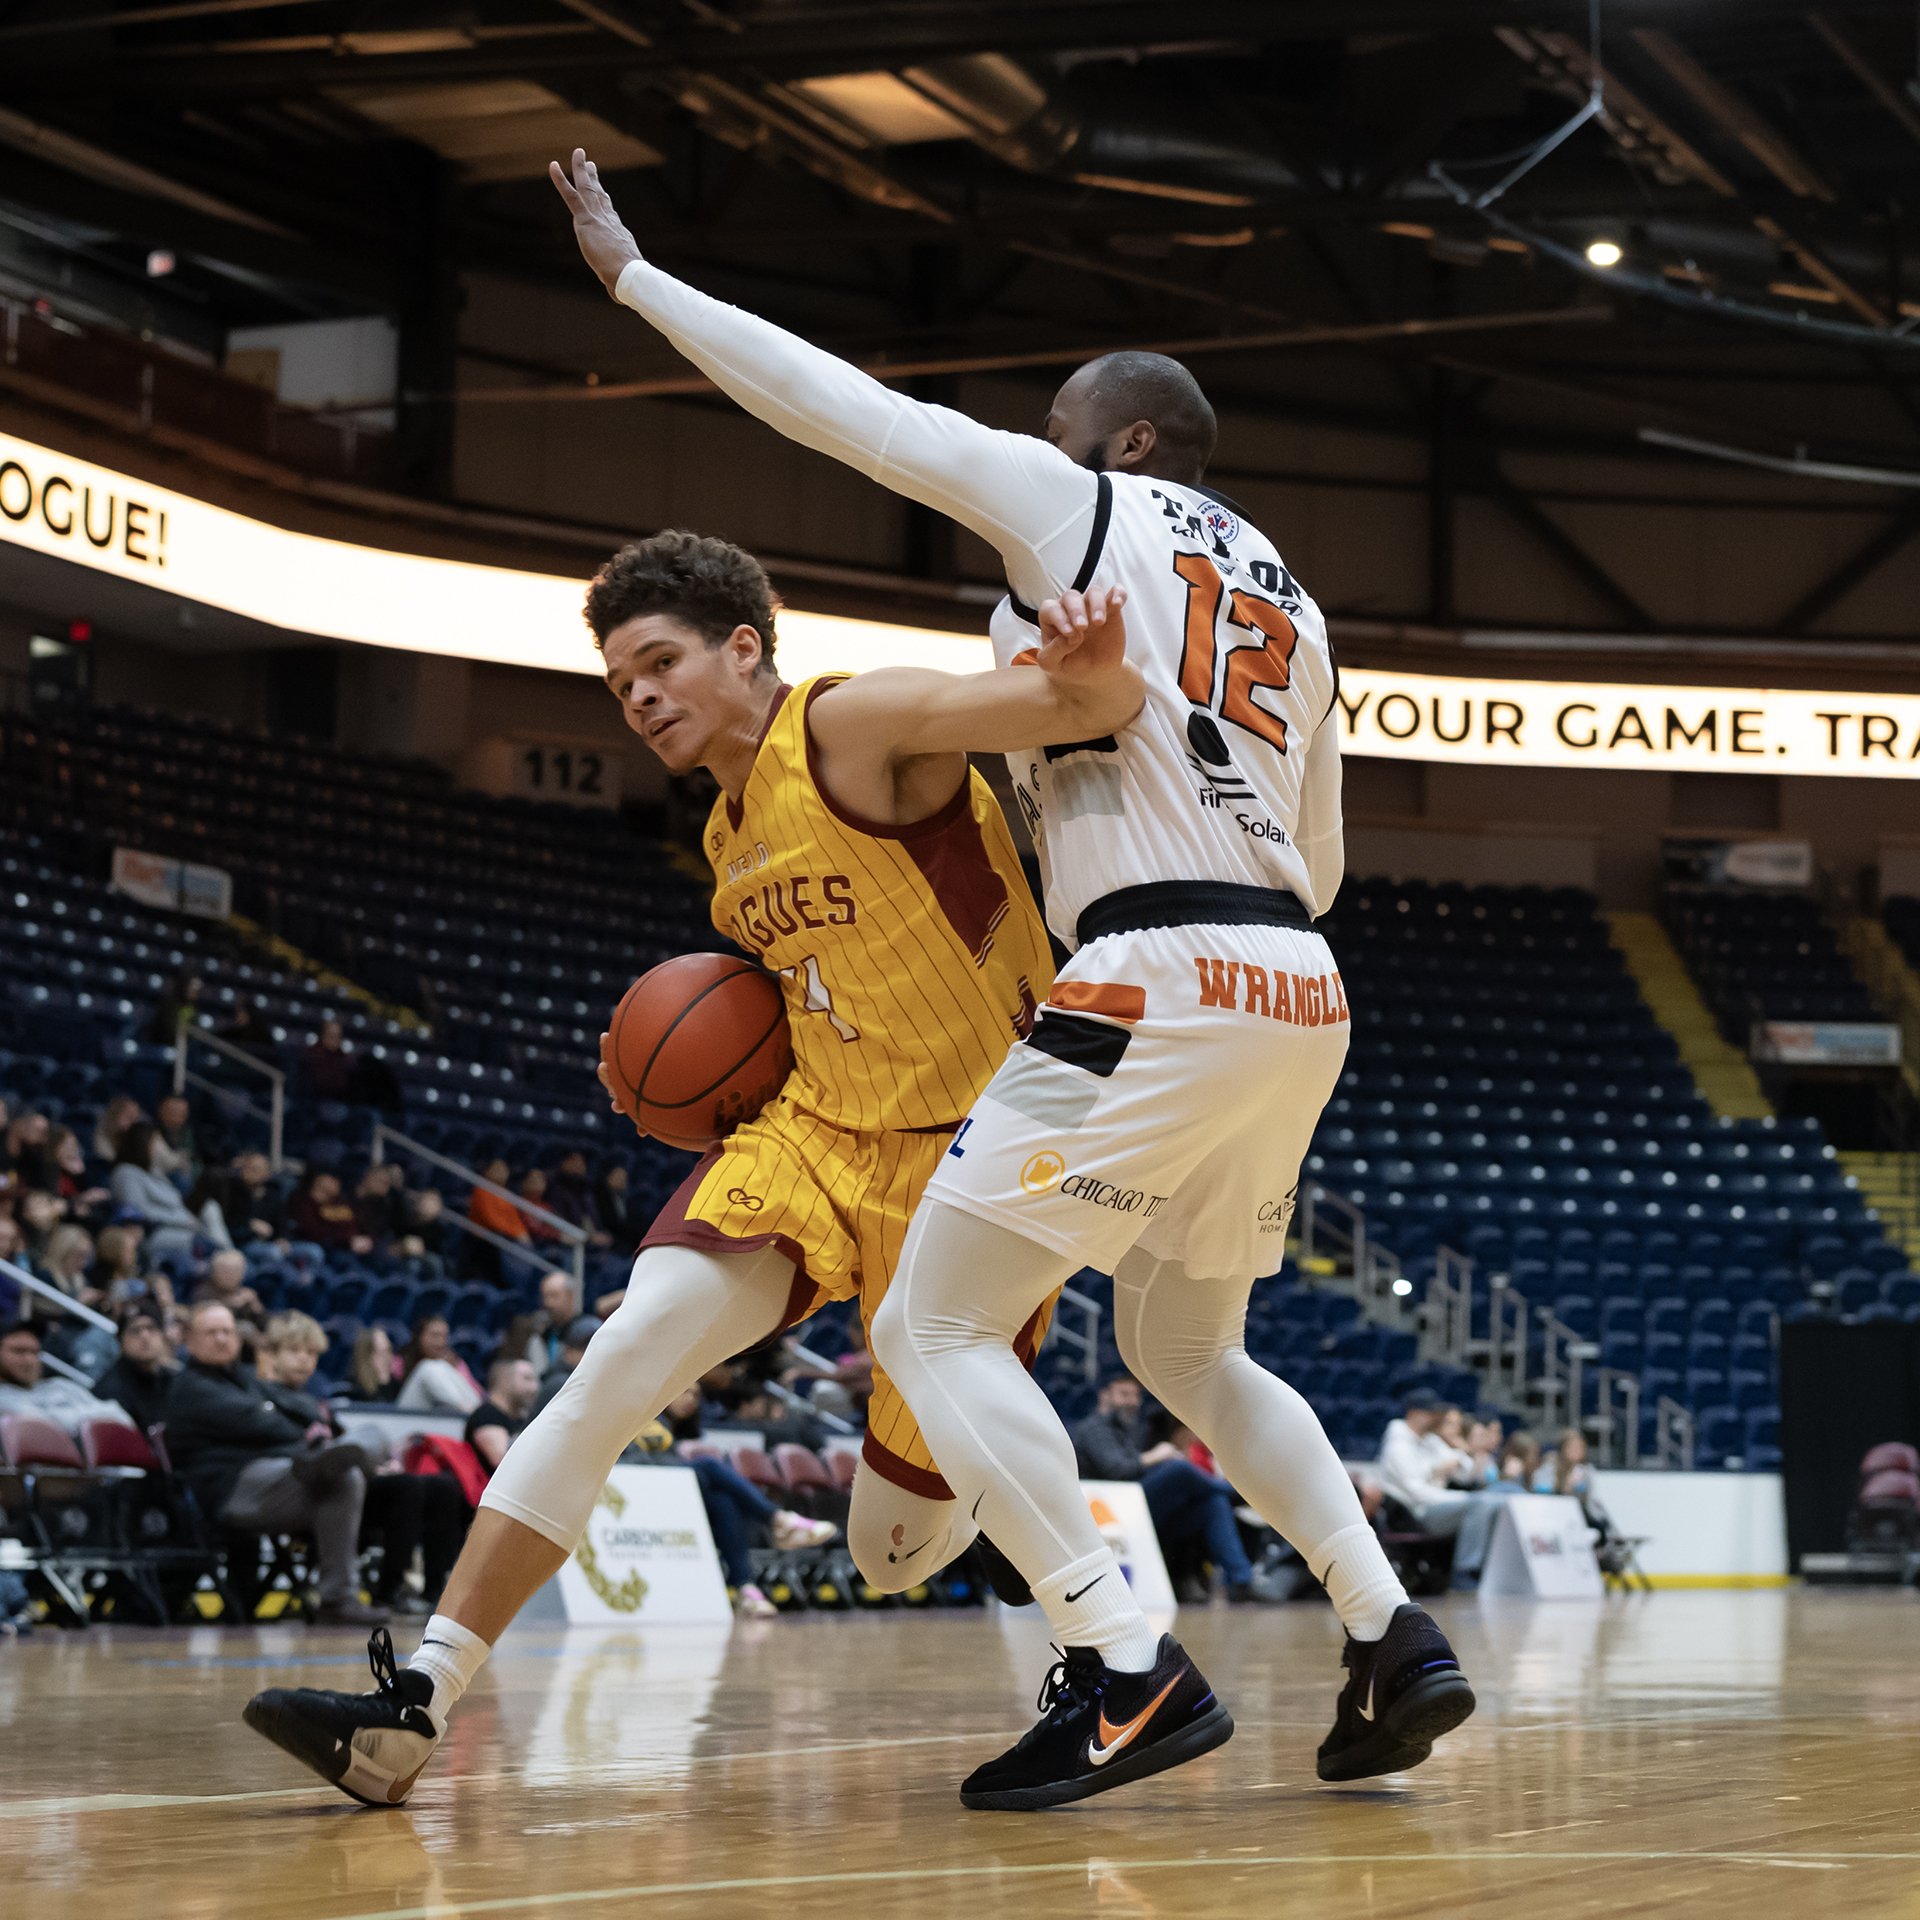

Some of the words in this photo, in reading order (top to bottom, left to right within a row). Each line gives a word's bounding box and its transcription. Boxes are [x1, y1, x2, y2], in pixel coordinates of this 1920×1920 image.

[1172, 549, 1300, 757] 12
[1339, 691, 1524, 746] YOUR
[1556, 703, 1786, 754] GAME.
[525, 749, 604, 795] 112
[730, 874, 857, 960] GUES
[1193, 957, 1350, 1028] WRANGLE
[1060, 1174, 1144, 1213] CHICAGO
